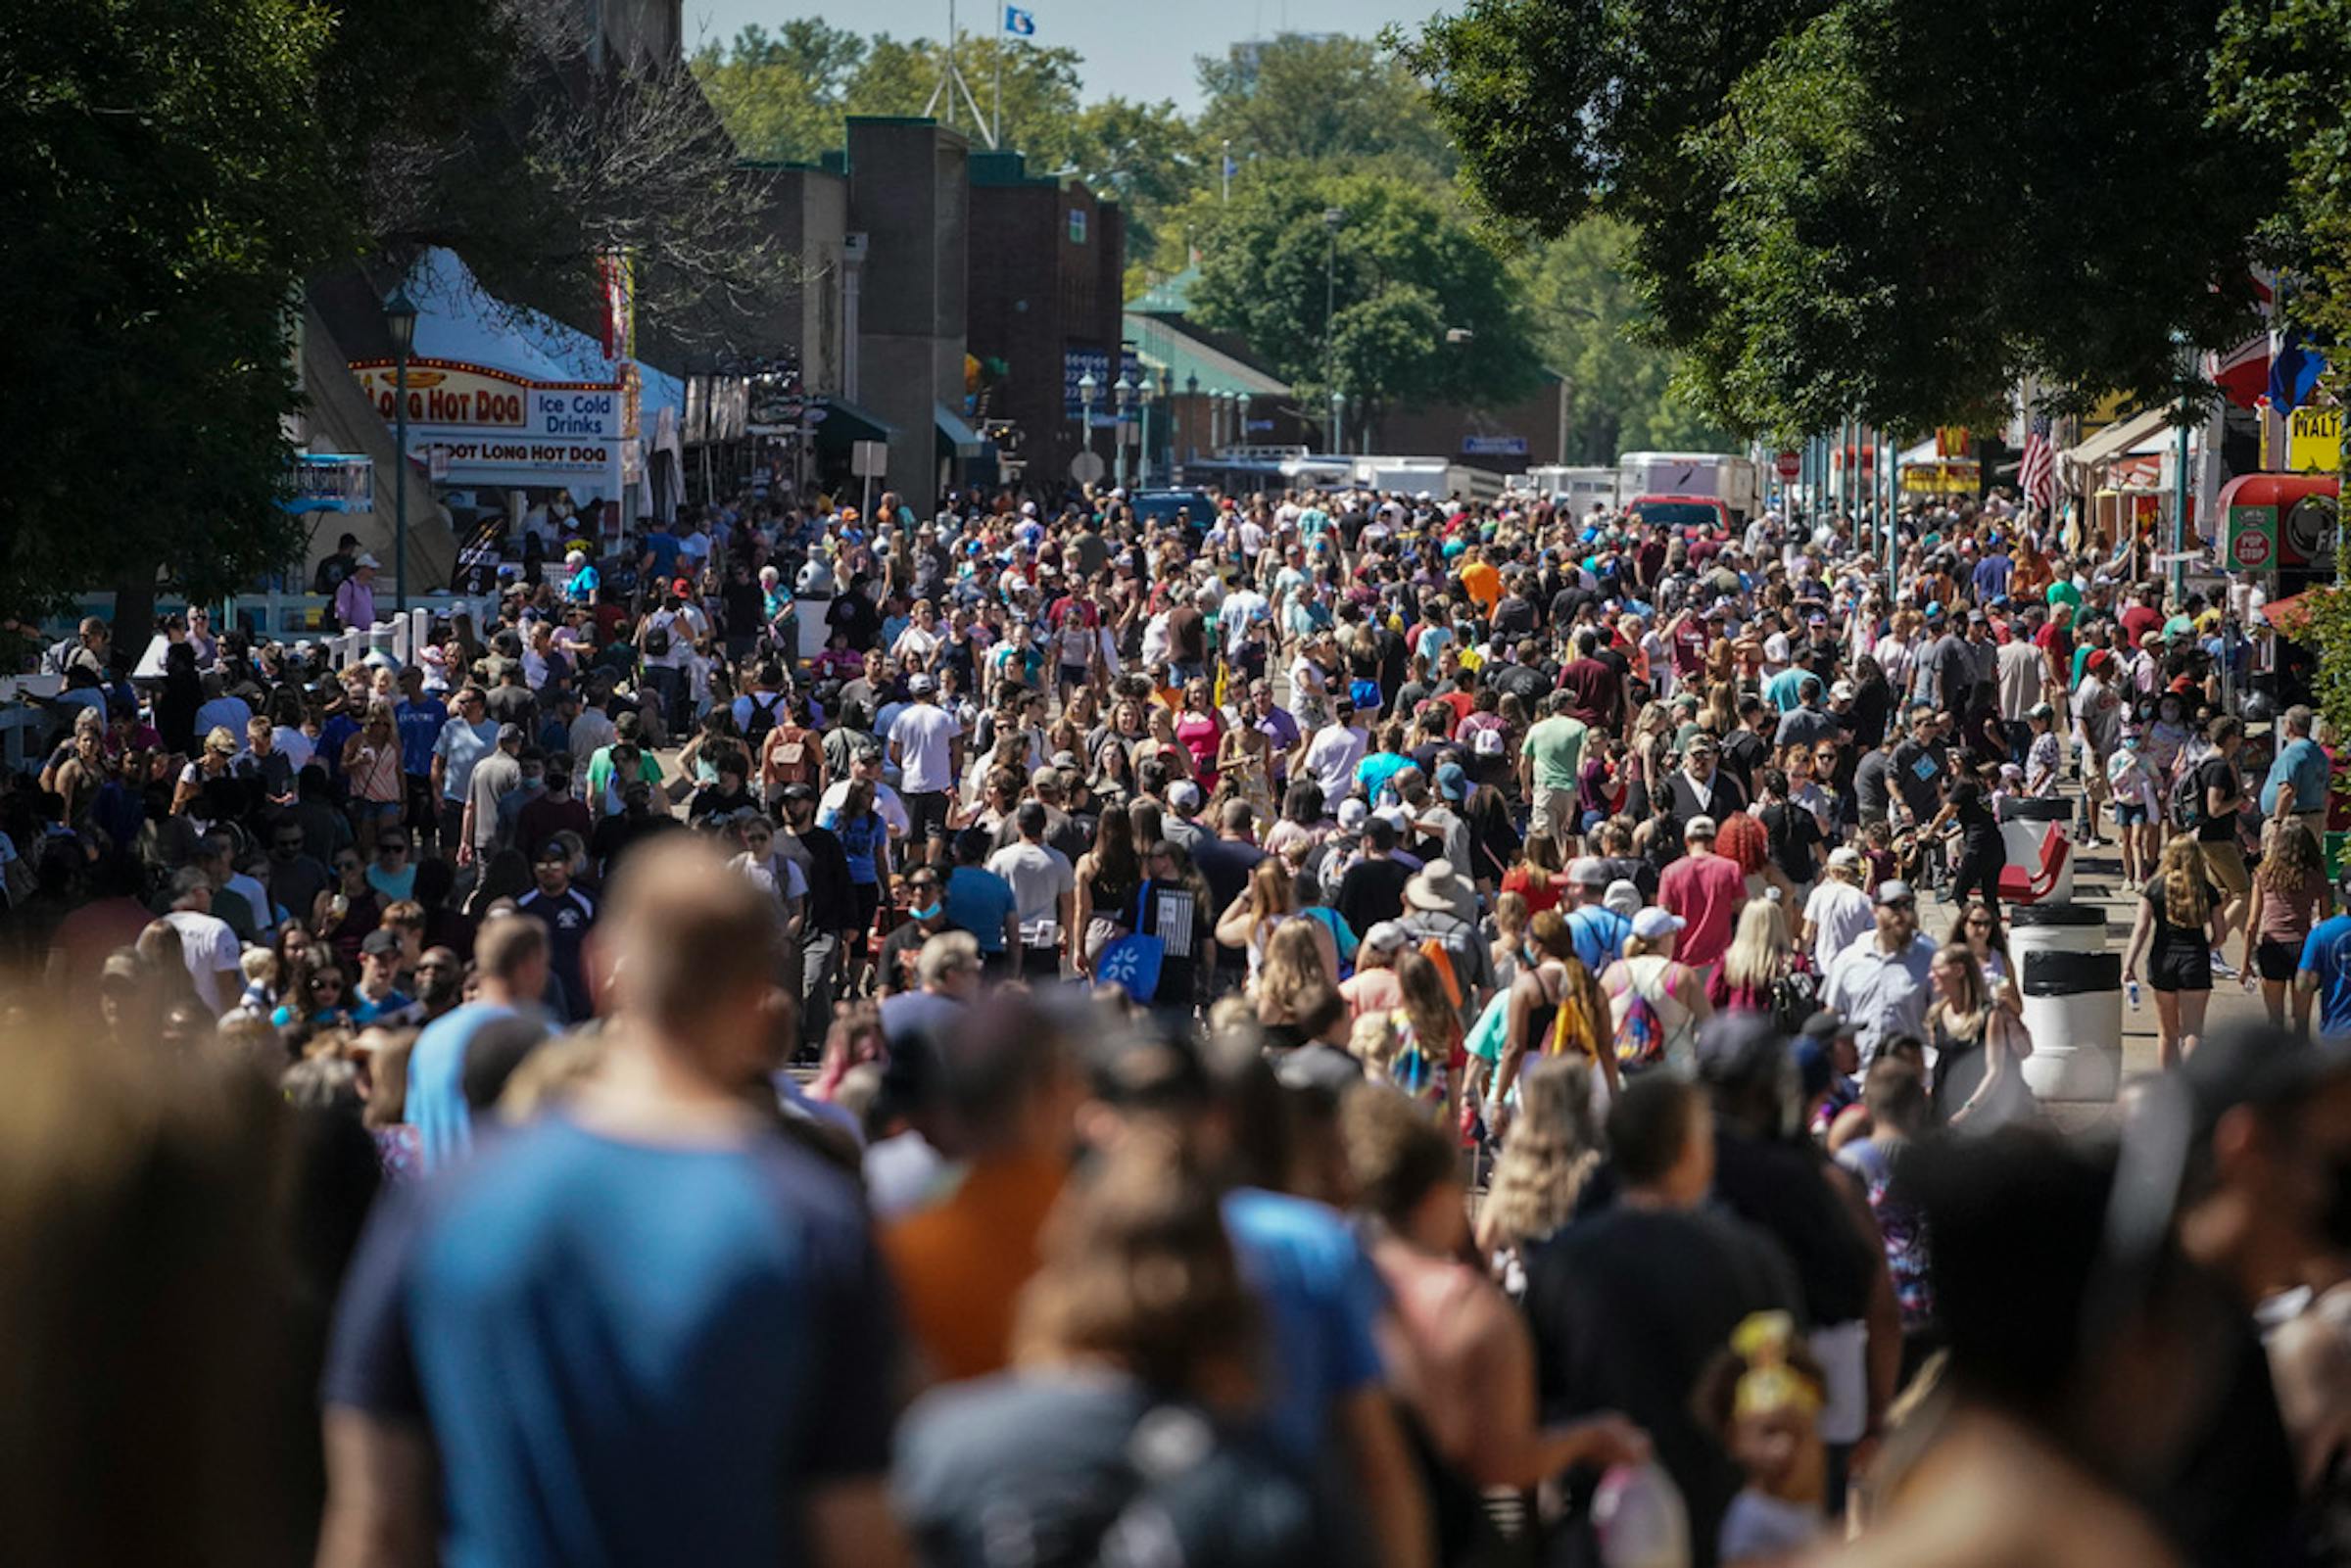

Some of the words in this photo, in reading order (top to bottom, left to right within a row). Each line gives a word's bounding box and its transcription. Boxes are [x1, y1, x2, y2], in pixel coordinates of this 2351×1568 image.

[368, 388, 422, 420] LOG
[428, 389, 470, 421] HOT
[475, 390, 520, 423] DOG
[539, 395, 564, 412] Ice
[572, 395, 610, 414] Cold
[547, 414, 602, 434] Drinks
[482, 443, 527, 460] LONG
[532, 445, 565, 460] HOT
[569, 447, 606, 462] DOG
[2238, 547, 2267, 560] STOP
